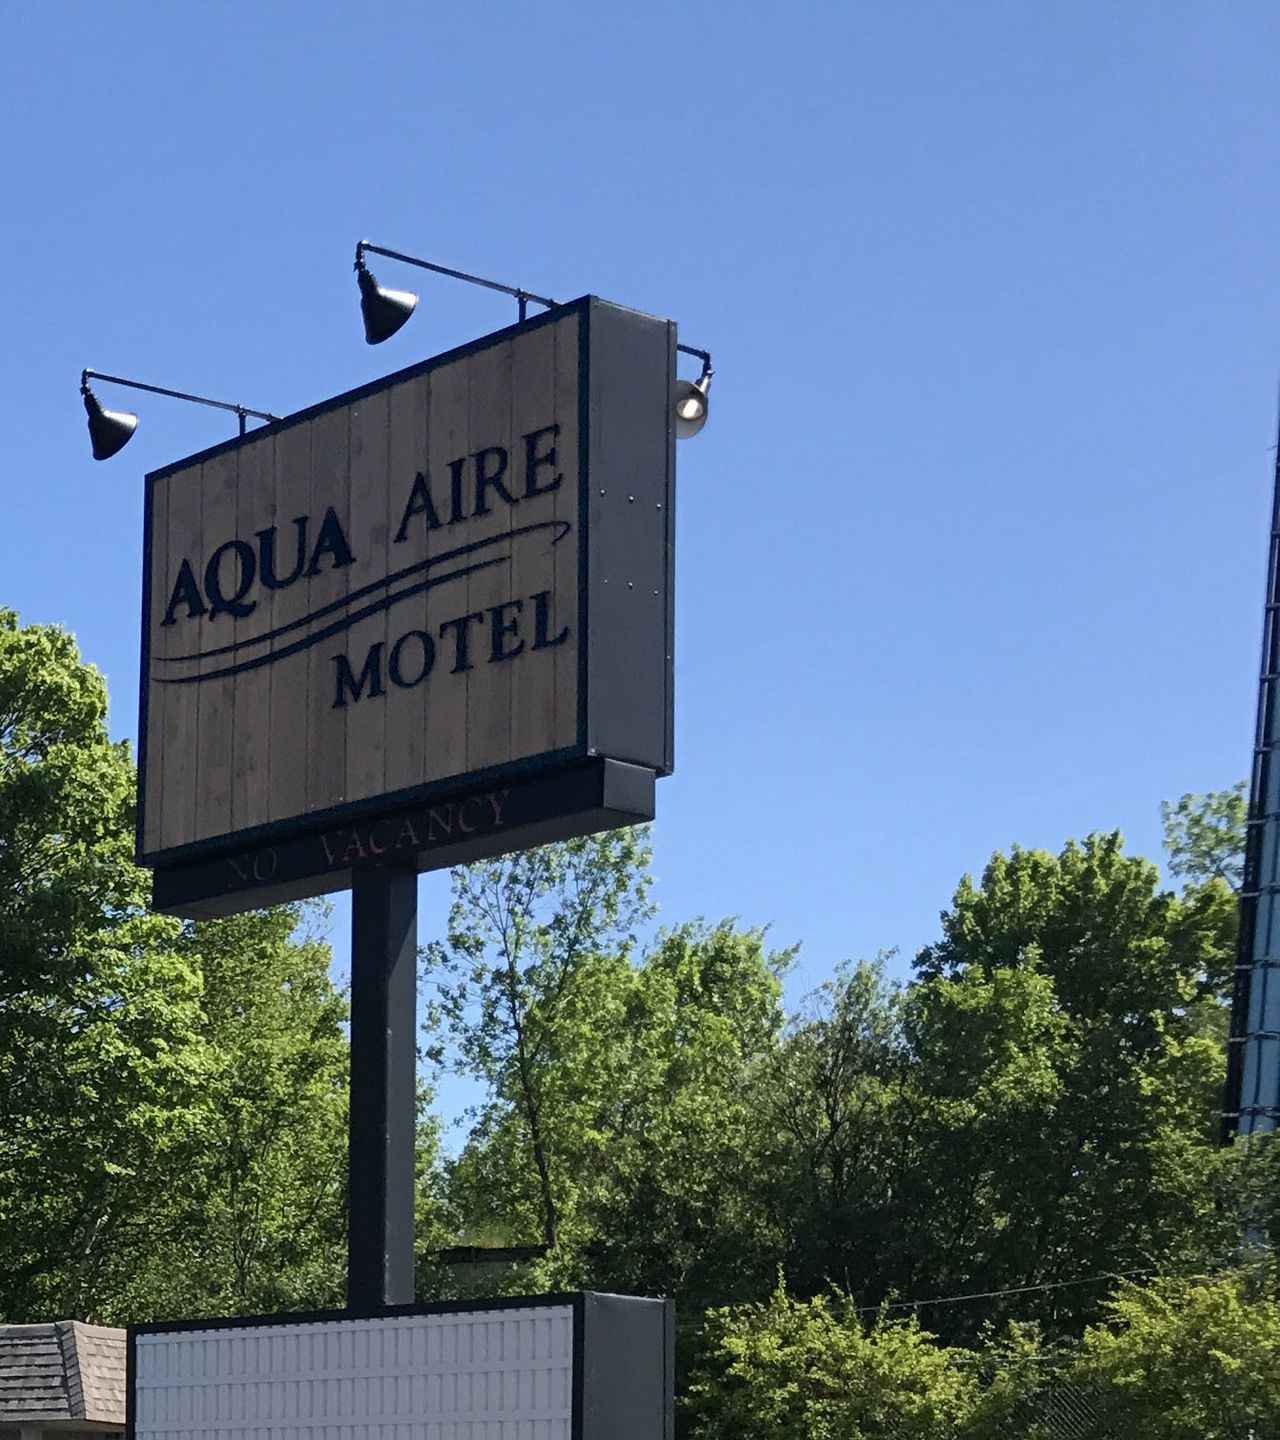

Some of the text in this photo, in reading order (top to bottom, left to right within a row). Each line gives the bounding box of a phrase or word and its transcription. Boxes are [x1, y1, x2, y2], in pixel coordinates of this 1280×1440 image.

[159, 423, 563, 627] AQUA AIRE
[329, 590, 570, 710] MOTEL
[225, 788, 510, 889] NO VACANCY
